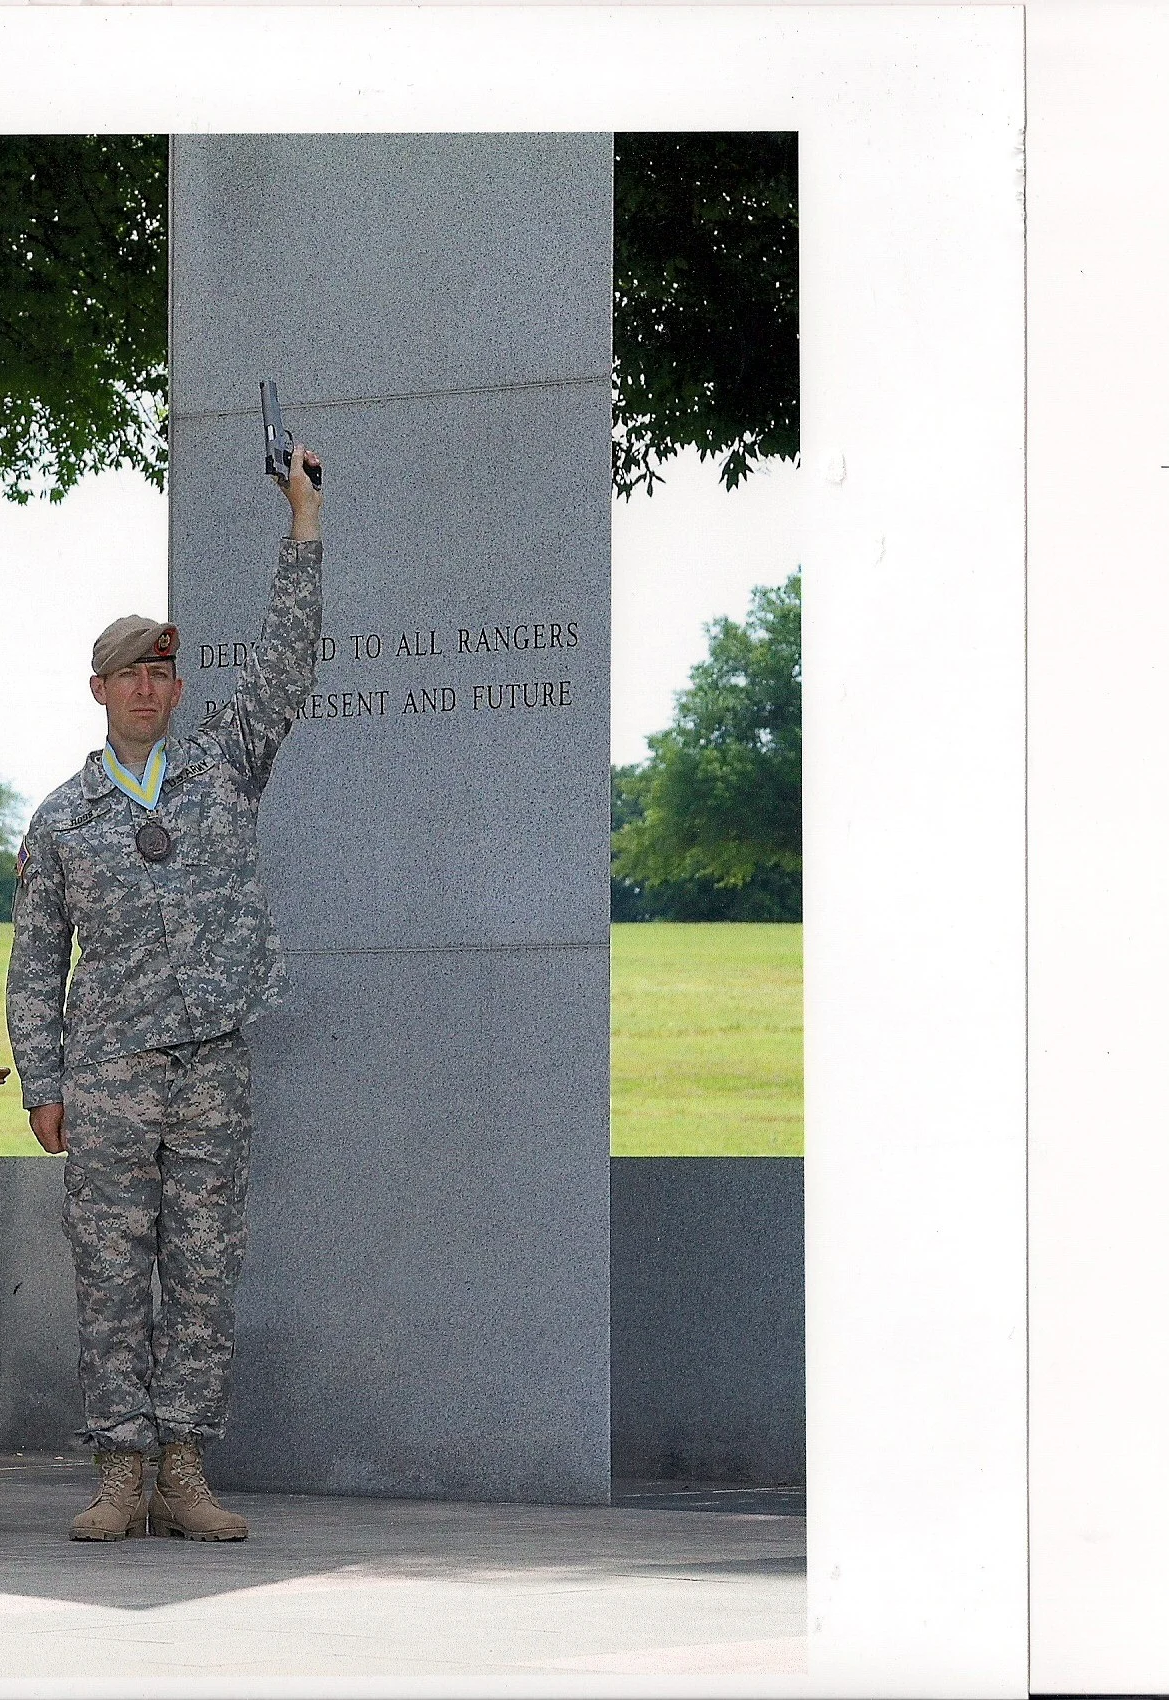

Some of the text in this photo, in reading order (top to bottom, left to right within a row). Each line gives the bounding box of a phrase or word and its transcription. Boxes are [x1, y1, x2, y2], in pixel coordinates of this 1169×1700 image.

[349, 633, 381, 660] TO
[395, 630, 443, 657] ALL
[457, 621, 579, 654] RANGERS
[295, 680, 572, 720] RESENT AND FUTURE
[185, 759, 208, 777] ARMY
